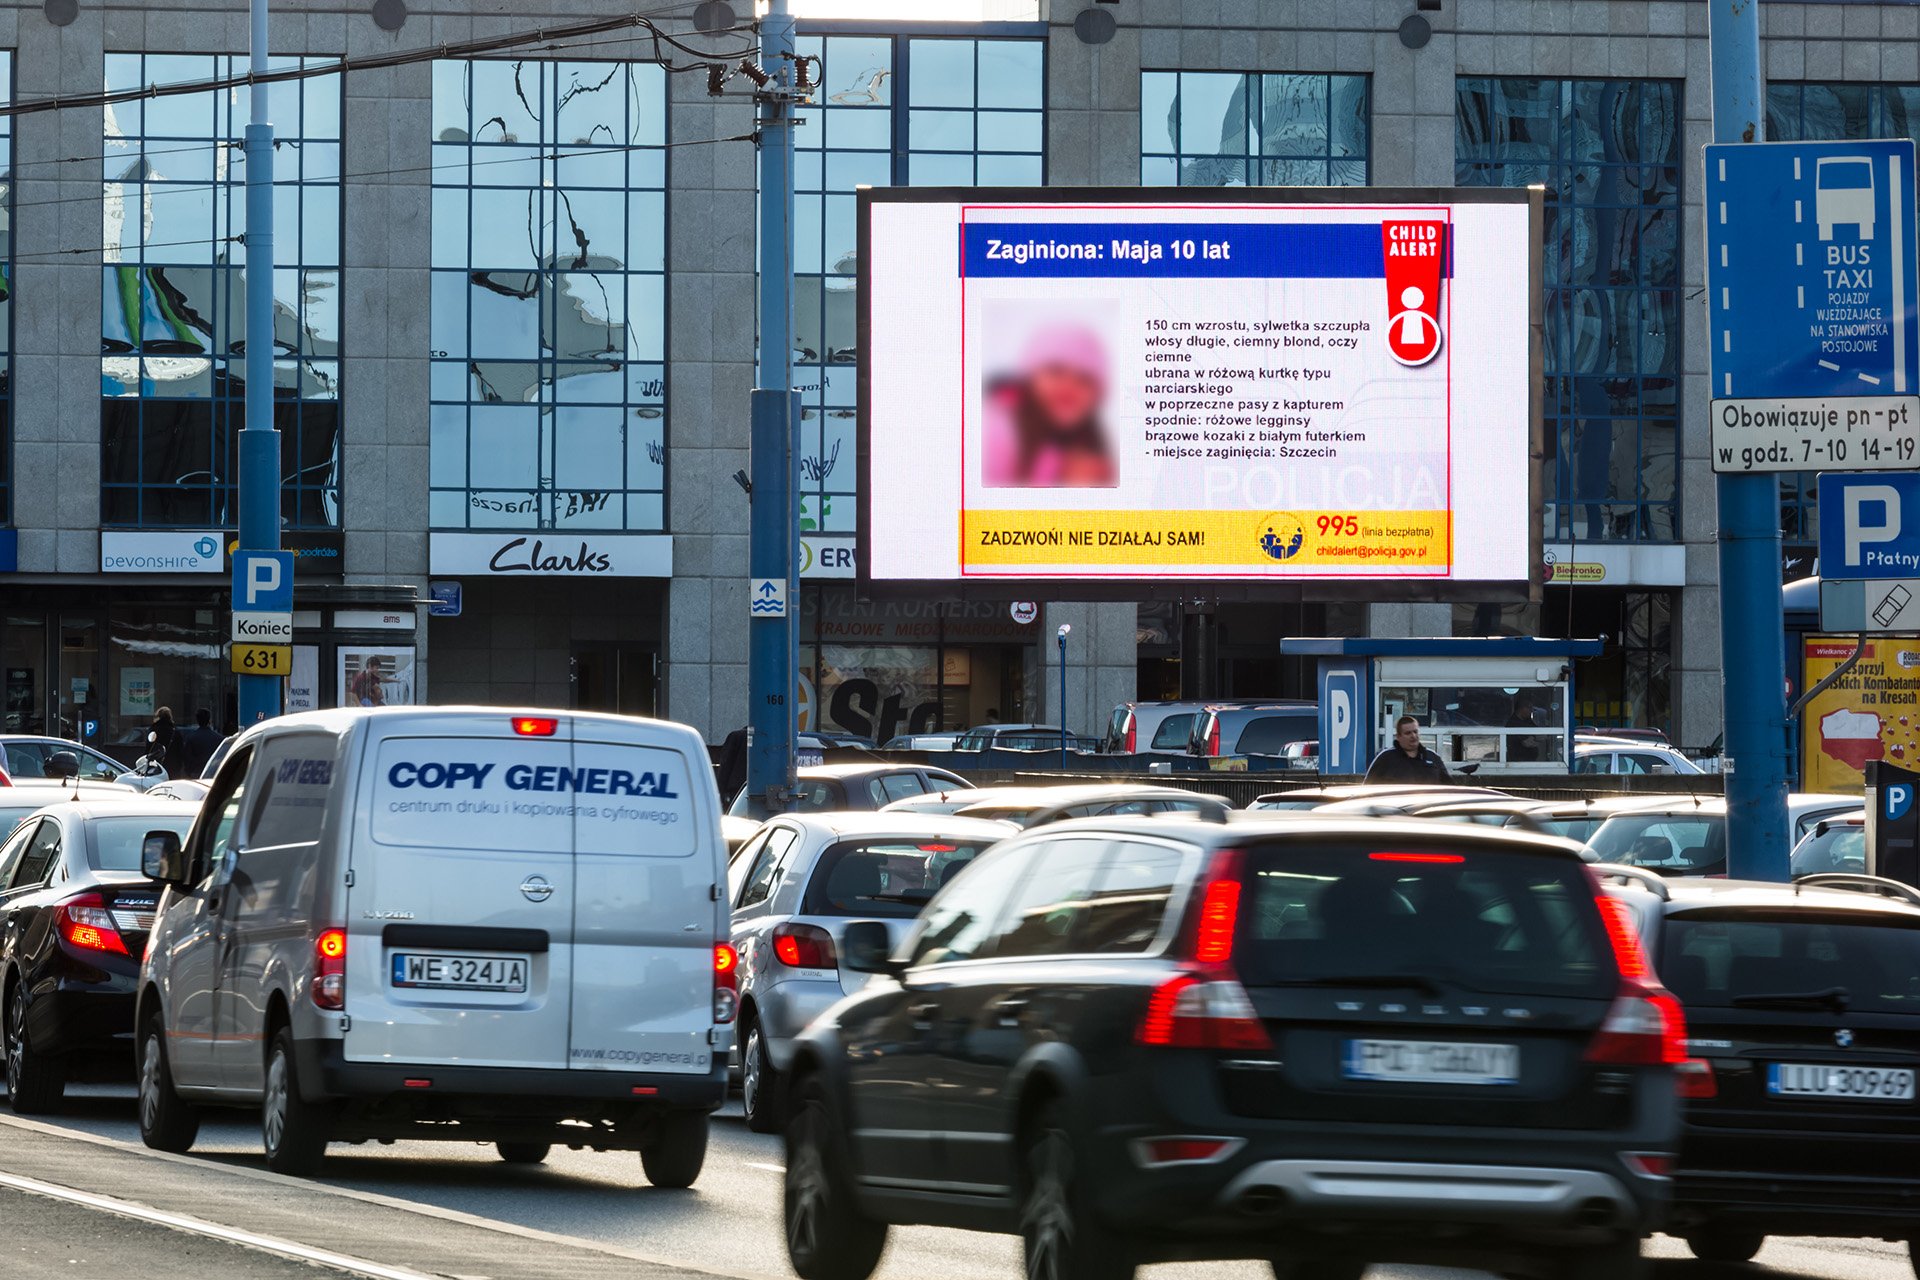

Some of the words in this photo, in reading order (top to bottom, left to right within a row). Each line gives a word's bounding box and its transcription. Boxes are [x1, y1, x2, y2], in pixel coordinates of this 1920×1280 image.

[1389, 225, 1437, 240] CHILD
[986, 239, 1104, 264] Zaginiona:
[1111, 239, 1163, 264] Maja
[1170, 239, 1196, 259] 10
[1203, 239, 1231, 259] lat
[1389, 241, 1437, 256] ALERT
[1827, 245, 1871, 265] BUS
[1823, 269, 1873, 289] TAXI
[1828, 292, 1870, 305] POJAZDY
[1145, 319, 1168, 331] 150
[1171, 321, 1191, 331] cm
[1195, 319, 1250, 333] wzrostu,
[1253, 319, 1310, 333] sylwetka
[1313, 319, 1371, 334] szczupła
[1810, 325, 1825, 338] NA
[1828, 324, 1889, 337] STANOWISKA
[1145, 336, 1183, 349] włosy
[1186, 336, 1230, 349] długie,
[1233, 336, 1280, 349] ciemny
[1283, 336, 1324, 348] blond,
[1327, 338, 1358, 349] oczy
[1821, 340, 1878, 353] POSTOJOWE
[1145, 352, 1192, 362] ciemne
[1145, 367, 1190, 379] ubrana
[1194, 369, 1205, 379] w
[1208, 367, 1255, 381] różową
[1259, 367, 1299, 381] kurtkę
[1302, 368, 1331, 381] typu
[1145, 383, 1234, 396] narciarskiego
[1145, 400, 1156, 410] w
[1159, 400, 1234, 412] poprzeczne
[1238, 400, 1269, 412] pasy
[1272, 401, 1280, 410] z
[1283, 398, 1344, 412] kapturem
[1145, 414, 1202, 427] spodnie:
[1205, 413, 1252, 426] różowe
[1256, 414, 1311, 428] legginsy
[1722, 403, 1838, 433] Obowiązuje
[1145, 430, 1199, 444] brązowe
[1203, 430, 1245, 441] kozaki
[1248, 432, 1256, 442] z
[1259, 430, 1301, 444] białym
[1305, 430, 1366, 442] futerkiem
[1153, 446, 1203, 459] miejsce
[1205, 446, 1276, 459] zaginięcia:
[1279, 446, 1337, 458] Szczecin
[1718, 447, 1733, 464] w
[1741, 440, 1794, 470] godz.
[1801, 439, 1847, 462] 7-10
[1861, 437, 1915, 461] 14-19
[1203, 463, 1444, 509] POLICJA
[1316, 515, 1358, 536] 995
[1361, 527, 1383, 538] (linia
[1385, 526, 1434, 539] bezpłatna)
[1843, 485, 1901, 566] P
[980, 527, 1064, 546] ZADZWOŃ!
[1068, 530, 1094, 546] NIE
[1098, 530, 1162, 546] DZIAŁAJ
[1166, 530, 1206, 546] SAM!
[488, 537, 611, 572] Clarks
[1316, 545, 1427, 558] childalert@policja.gov.pl
[1866, 551, 1920, 570] Płatny
[1556, 565, 1602, 574] Biedronka
[246, 557, 281, 604] P
[238, 615, 291, 636] Koniec
[383, 615, 401, 624] ams
[816, 621, 885, 637] KRAJOWE
[243, 649, 279, 669] 631
[766, 694, 784, 706] 160
[1862, 693, 1876, 704] na
[1880, 690, 1917, 705] Kresach
[388, 761, 496, 789] COPY
[504, 763, 679, 800] GENERAL
[1889, 787, 1906, 814] P
[388, 800, 452, 814] centrum
[456, 799, 501, 815] druku
[512, 801, 598, 823] kopiowania
[601, 804, 679, 825] cyfrowego
[409, 957, 443, 982] WE
[450, 960, 523, 985] 324JA
[1782, 1064, 1829, 1093] LLU
[1836, 1067, 1912, 1098] 30969
